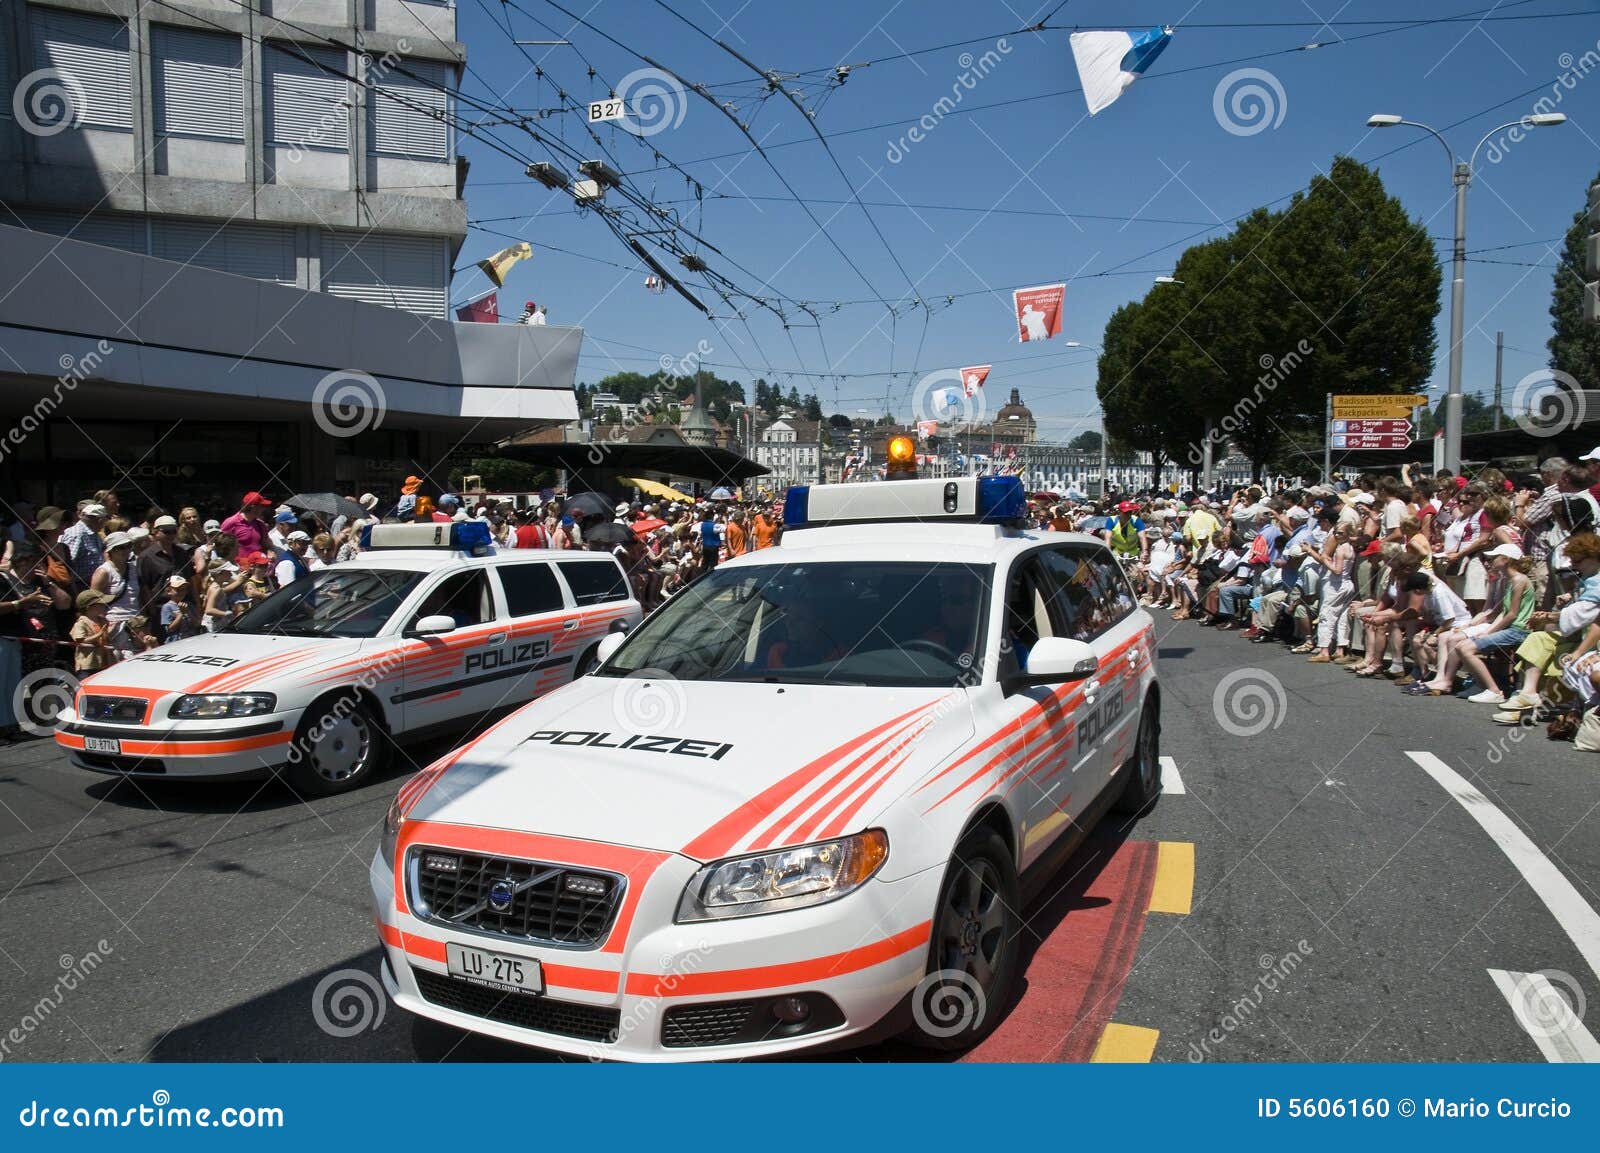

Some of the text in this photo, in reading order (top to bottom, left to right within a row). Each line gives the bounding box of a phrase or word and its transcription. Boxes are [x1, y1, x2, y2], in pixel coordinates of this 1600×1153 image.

[591, 102, 621, 120] B 27
[1338, 397, 1418, 405] Radisson SAS Hotel
[1337, 409, 1388, 417] Backpackers
[127, 654, 241, 668] POLIZEI
[465, 639, 550, 675] POLIZEI
[1078, 688, 1124, 755] POLIZEI
[517, 730, 735, 761] POLIZEI
